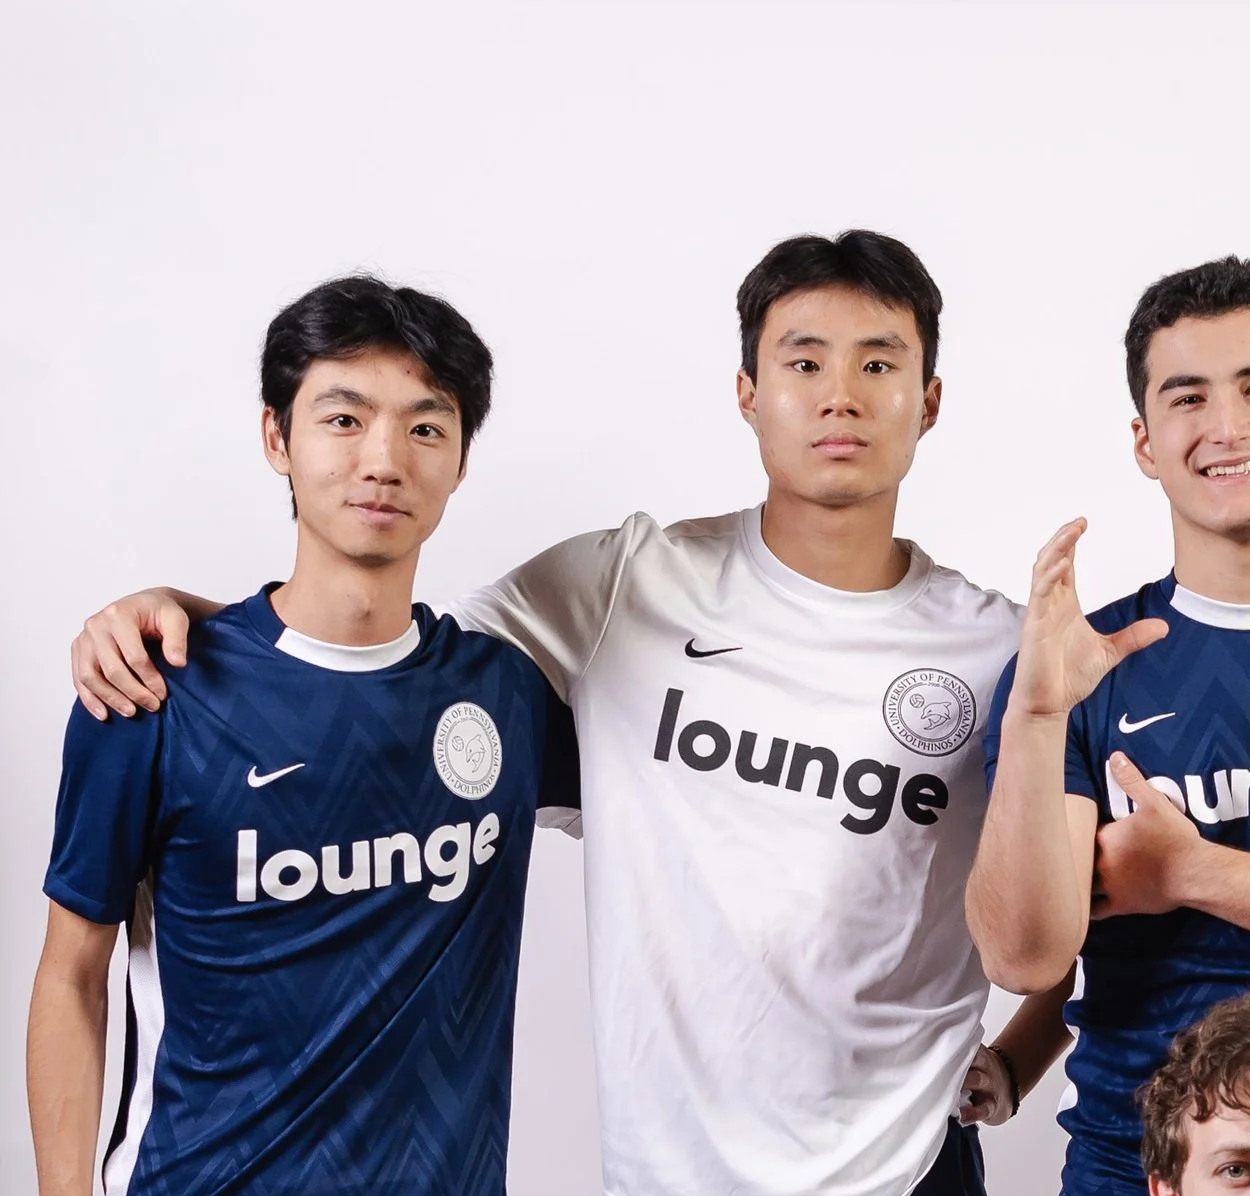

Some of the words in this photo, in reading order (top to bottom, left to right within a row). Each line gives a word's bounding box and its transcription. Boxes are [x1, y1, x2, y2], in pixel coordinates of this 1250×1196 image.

[436, 717, 453, 781] UNIVERSITY
[451, 707, 462, 719] OF
[463, 706, 499, 767] PENNSYLVANIA
[888, 675, 917, 726] UNIVERSITY
[919, 673, 935, 682] OF
[937, 675, 972, 739] PENNSYLVANIA
[898, 728, 954, 752] DOLPHINOS
[653, 687, 949, 835] lounge
[237, 812, 500, 902] lounge
